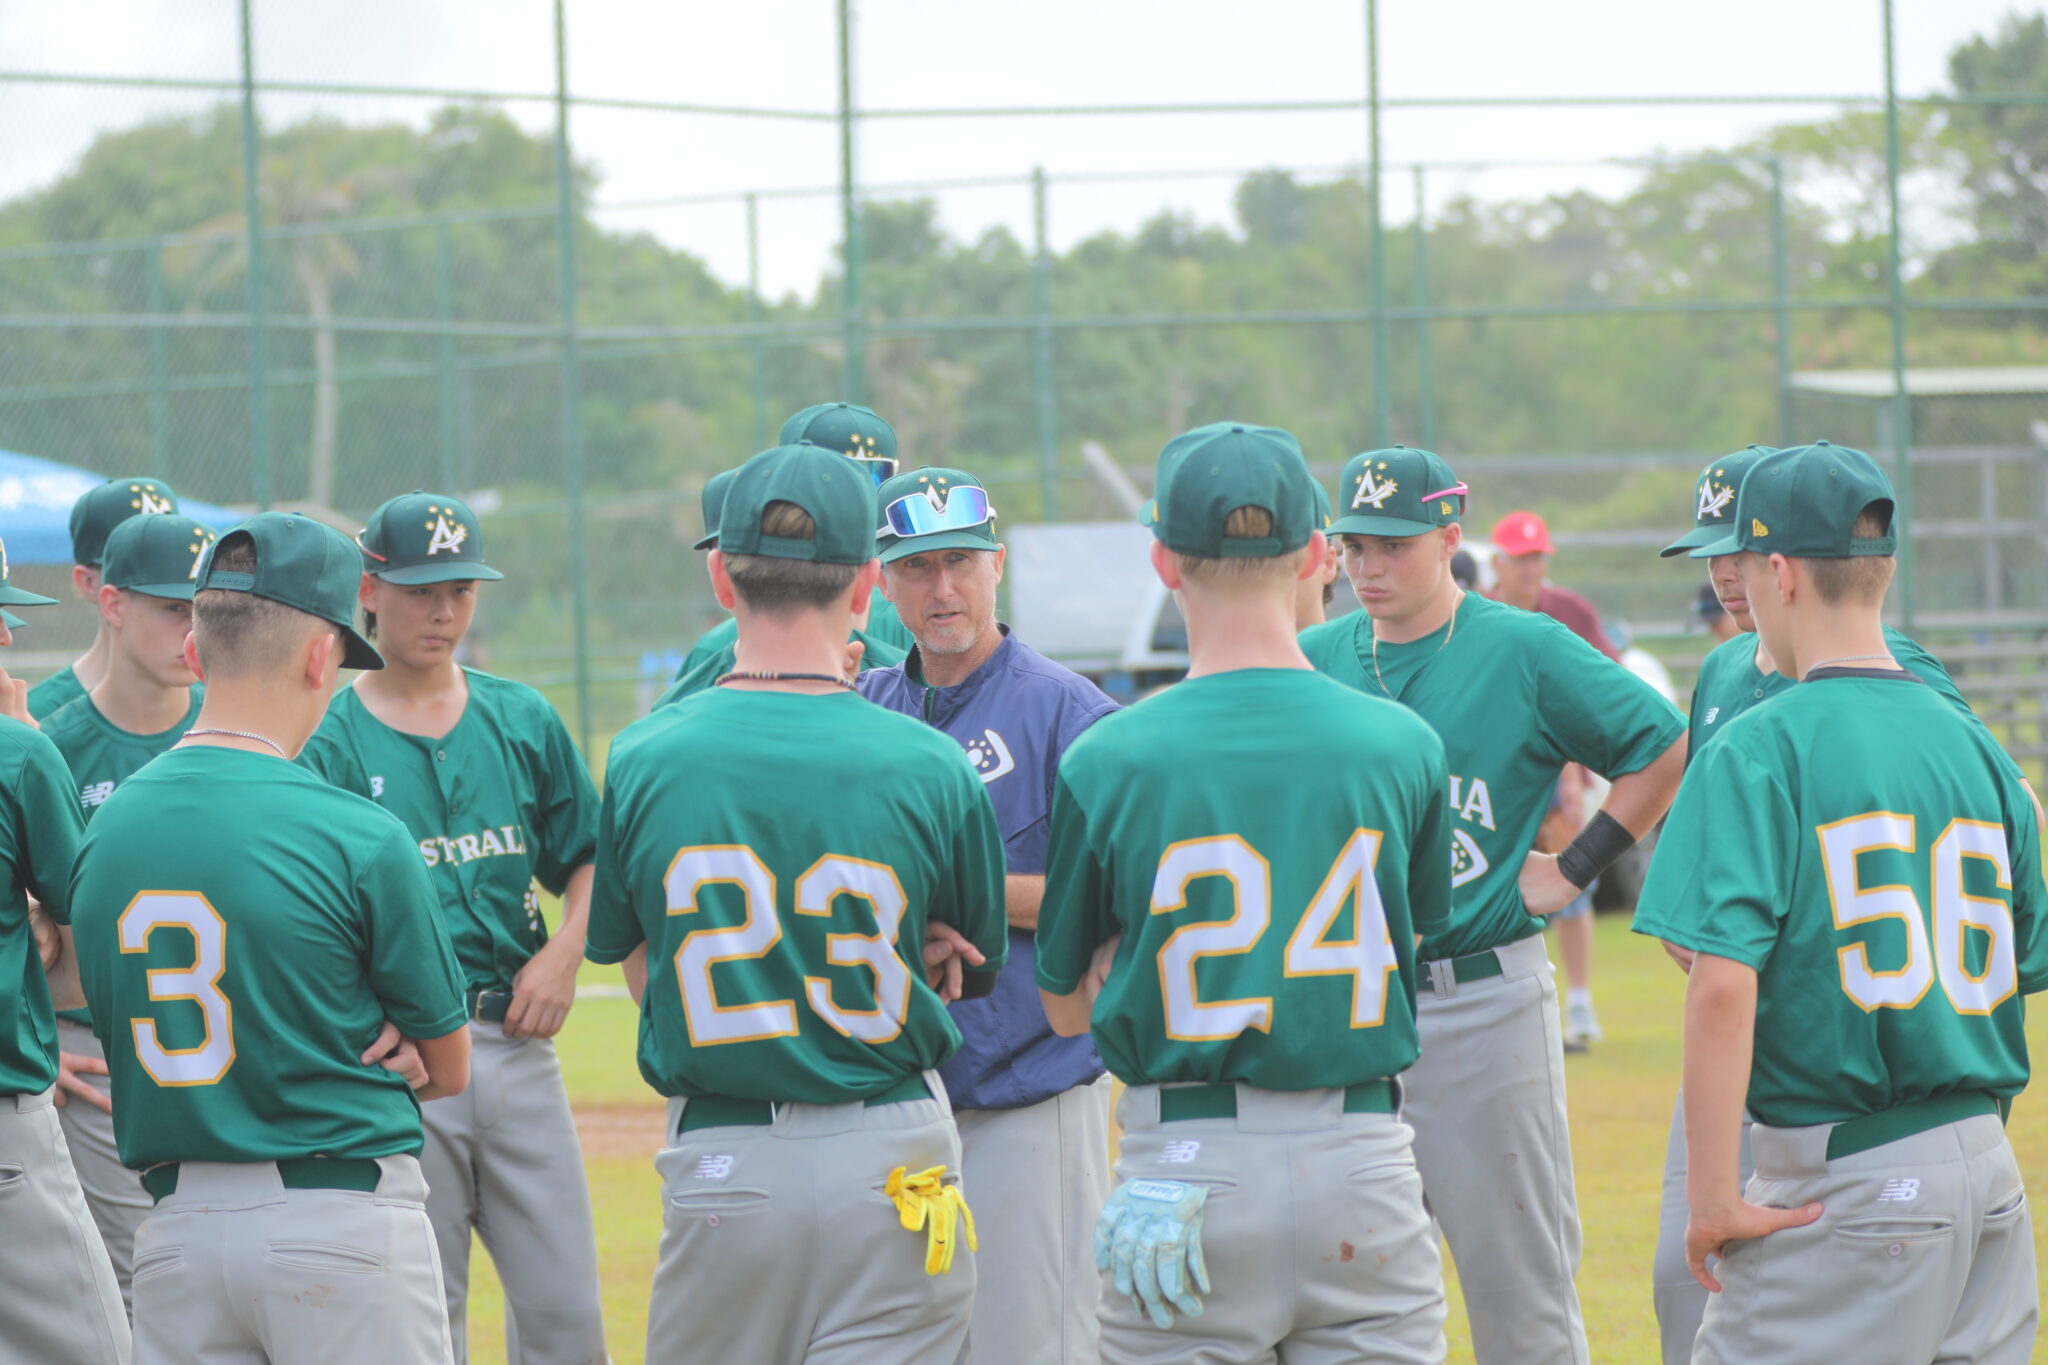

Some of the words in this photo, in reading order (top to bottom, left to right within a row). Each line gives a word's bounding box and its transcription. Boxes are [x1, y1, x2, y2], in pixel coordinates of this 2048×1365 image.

[419, 824, 526, 868] STRAL
[1449, 774, 1496, 832] IA
[117, 888, 237, 1088] 3
[664, 843, 913, 1049] 23
[1150, 827, 1398, 1043] 24
[1815, 810, 2018, 1017] 56
